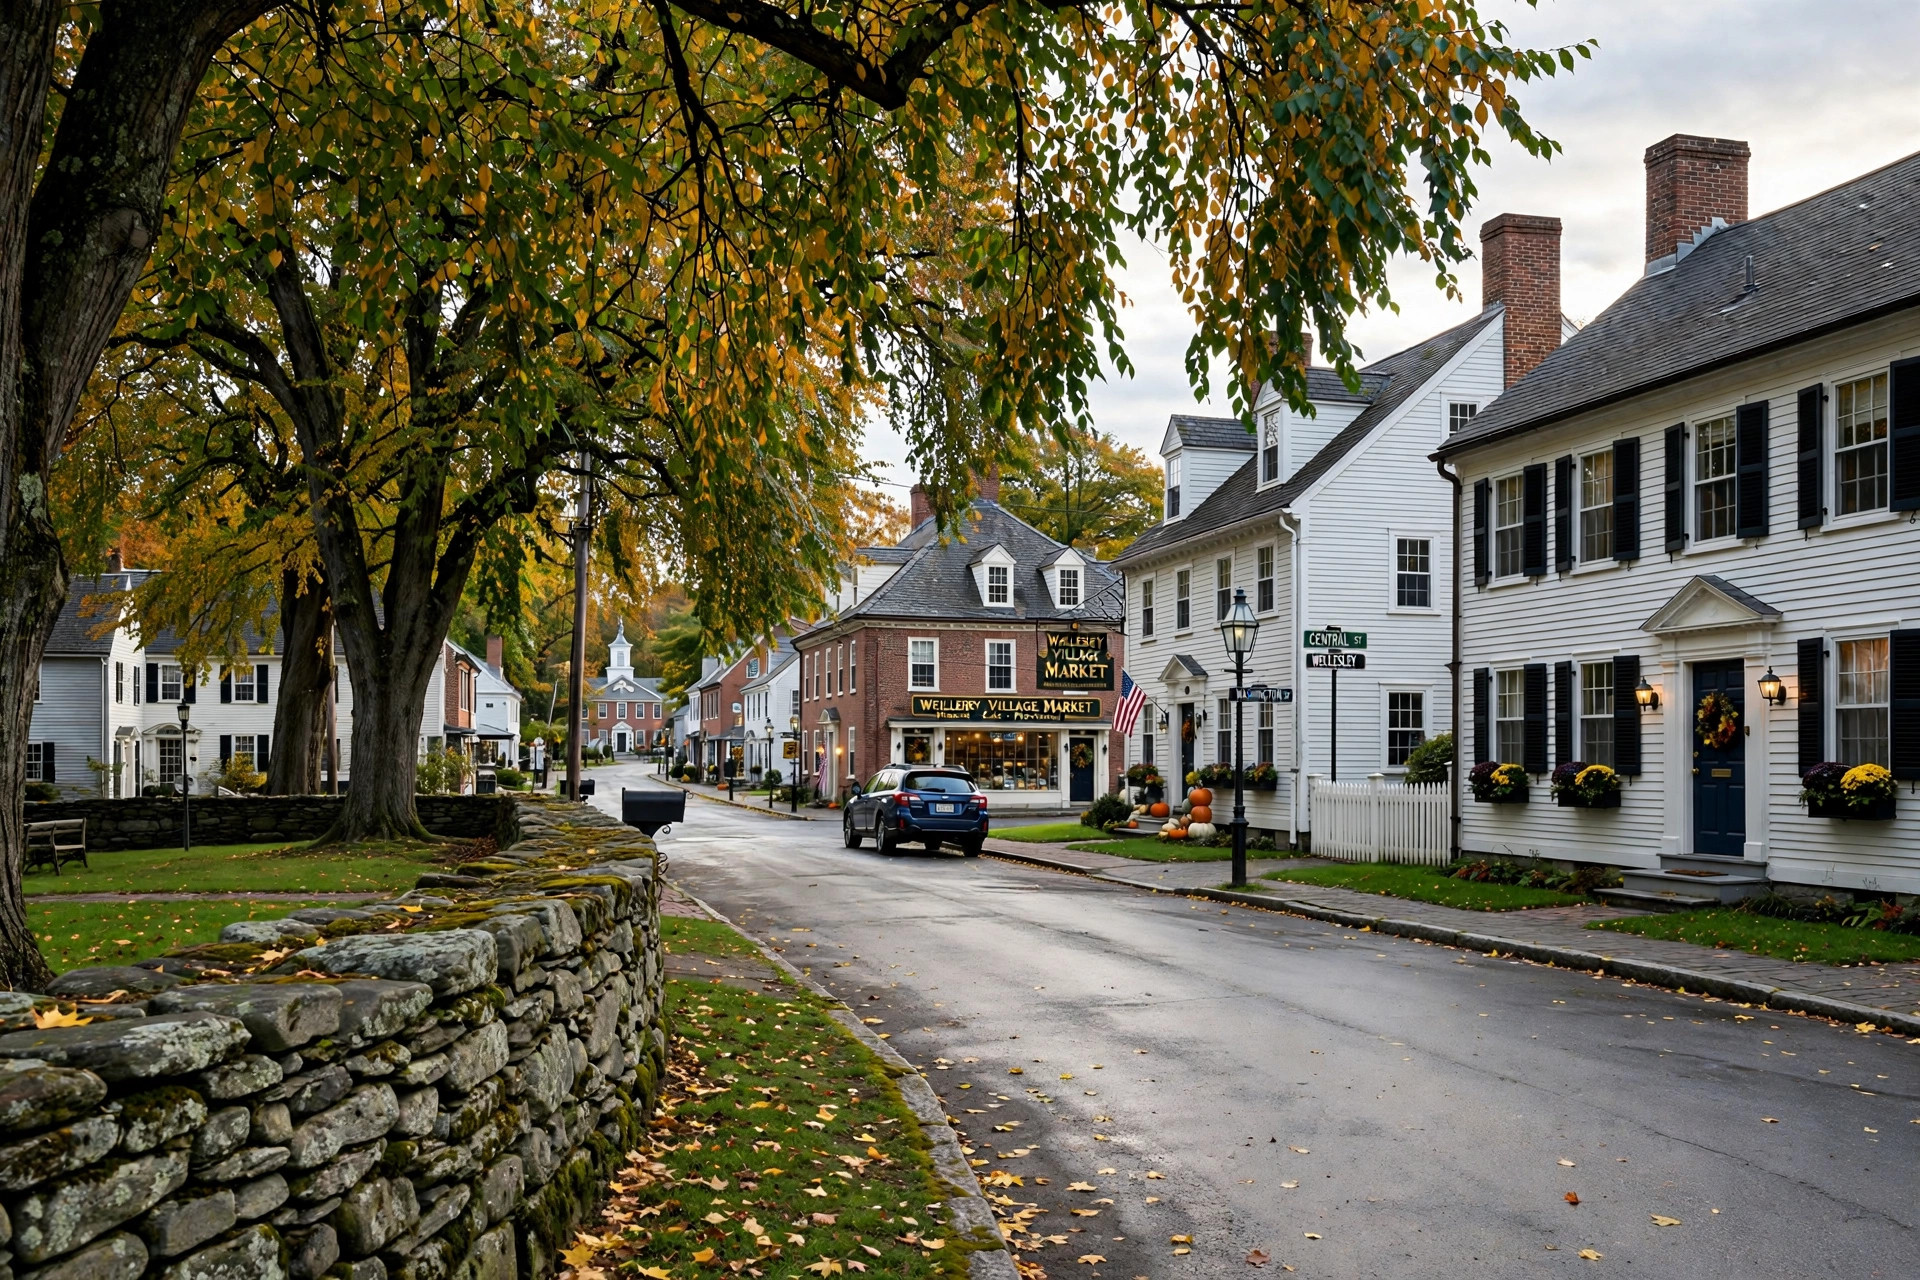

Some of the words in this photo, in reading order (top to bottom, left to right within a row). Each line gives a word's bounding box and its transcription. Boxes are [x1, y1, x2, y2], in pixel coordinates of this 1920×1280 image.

[1309, 632, 1349, 646] CENTRAL
[1354, 636, 1362, 644] ST
[1045, 661, 1108, 679] MARKET
[988, 700, 1039, 712] VILLAGE
[1043, 699, 1094, 713] MARKET
